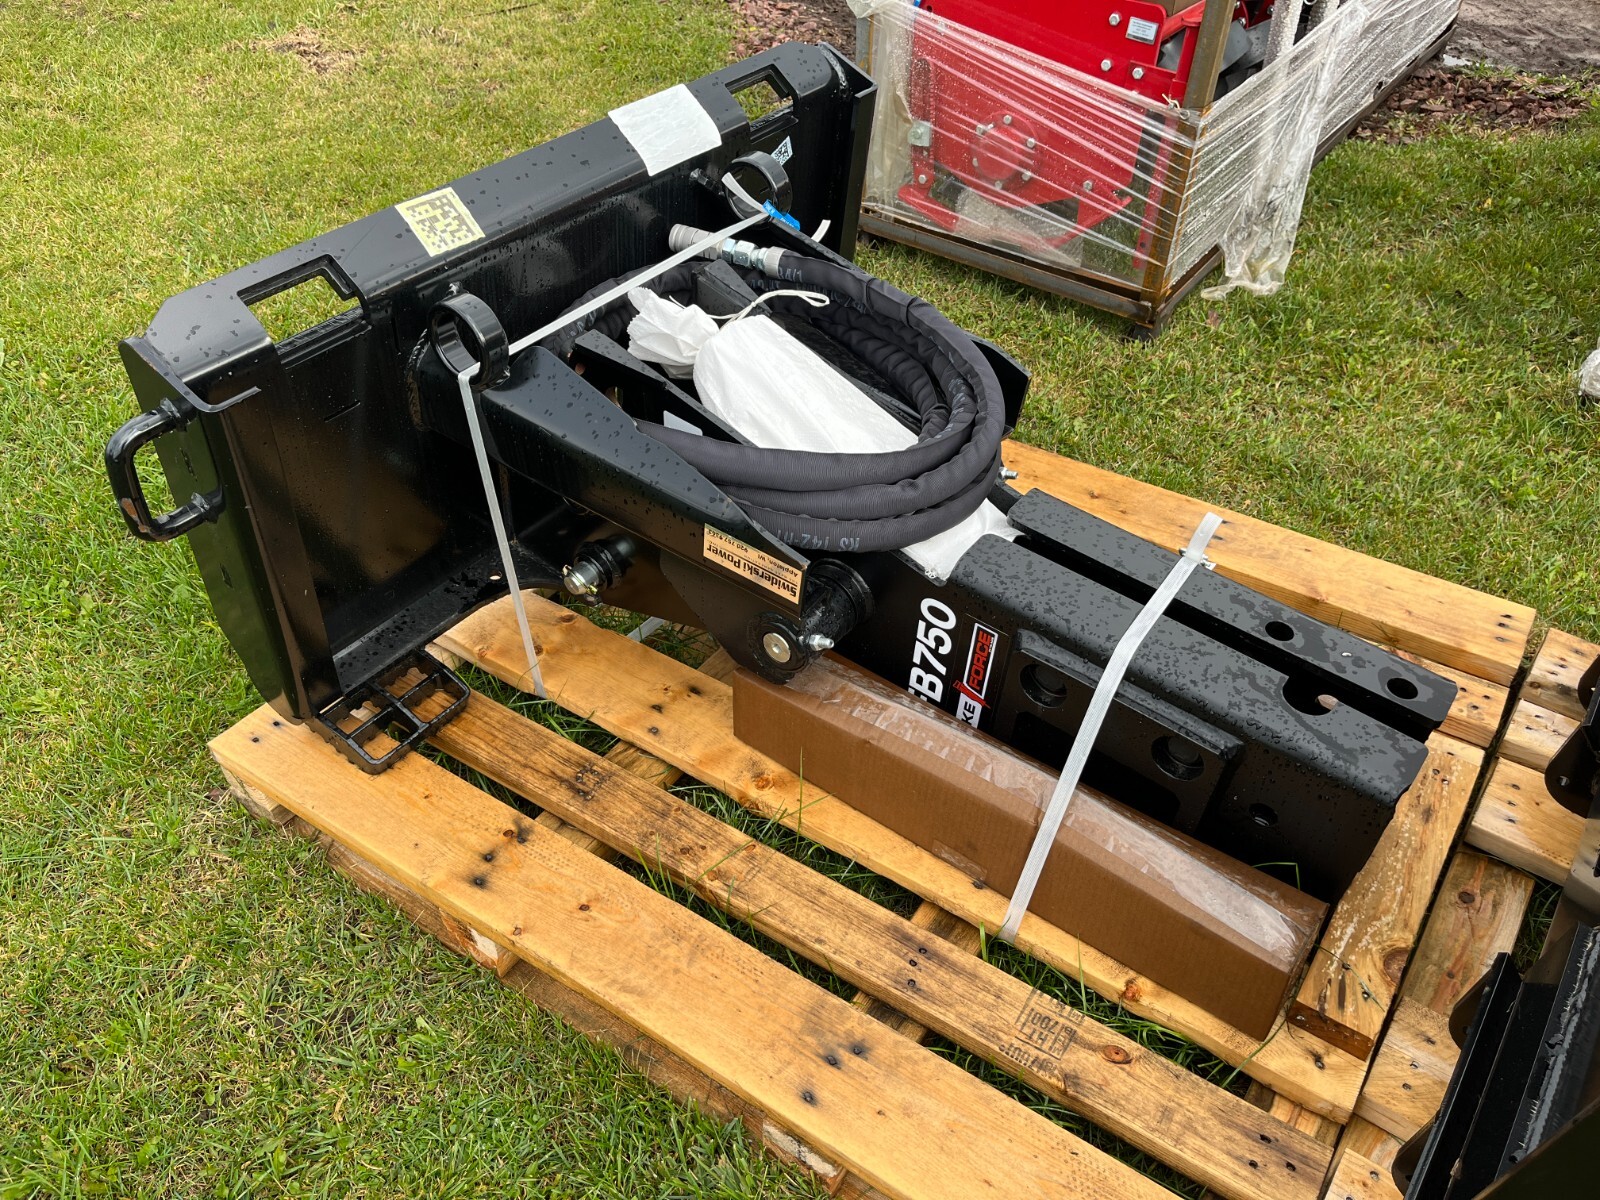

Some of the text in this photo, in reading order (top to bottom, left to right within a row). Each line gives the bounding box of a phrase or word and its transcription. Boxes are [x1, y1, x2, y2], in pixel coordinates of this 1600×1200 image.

[706, 544, 798, 597] Swiderski Power
[757, 553, 766, 562] WI
[969, 630, 992, 689] FORCE
[1030, 1012, 1060, 1035] 700
